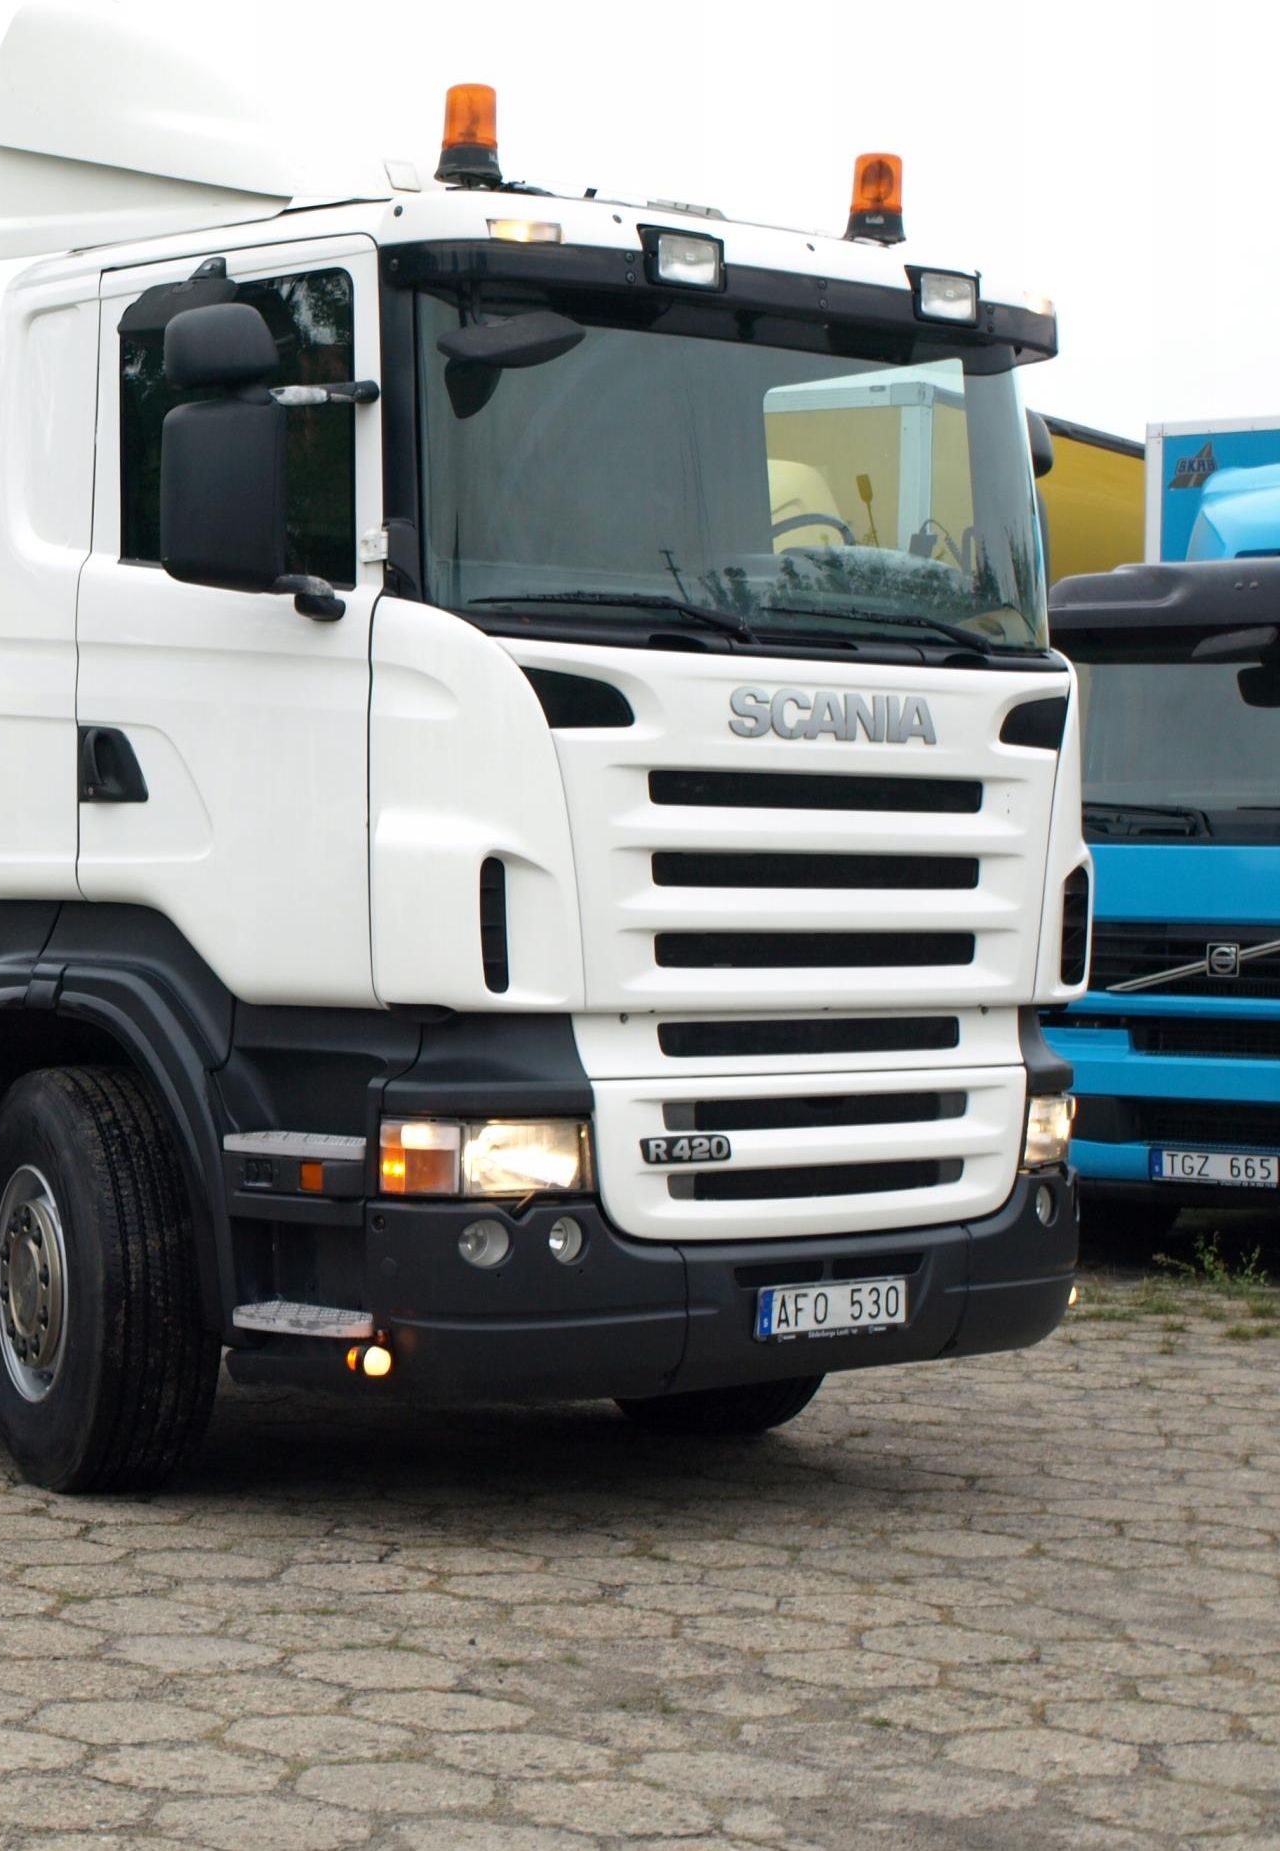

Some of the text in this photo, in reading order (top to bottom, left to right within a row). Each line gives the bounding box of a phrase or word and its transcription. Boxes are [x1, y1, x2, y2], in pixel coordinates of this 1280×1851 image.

[728, 686, 937, 745] SCANIA
[648, 1136, 729, 1161] R 420
[1166, 1153, 1271, 1180] TGZ 665
[776, 1285, 899, 1328] AFO 530
